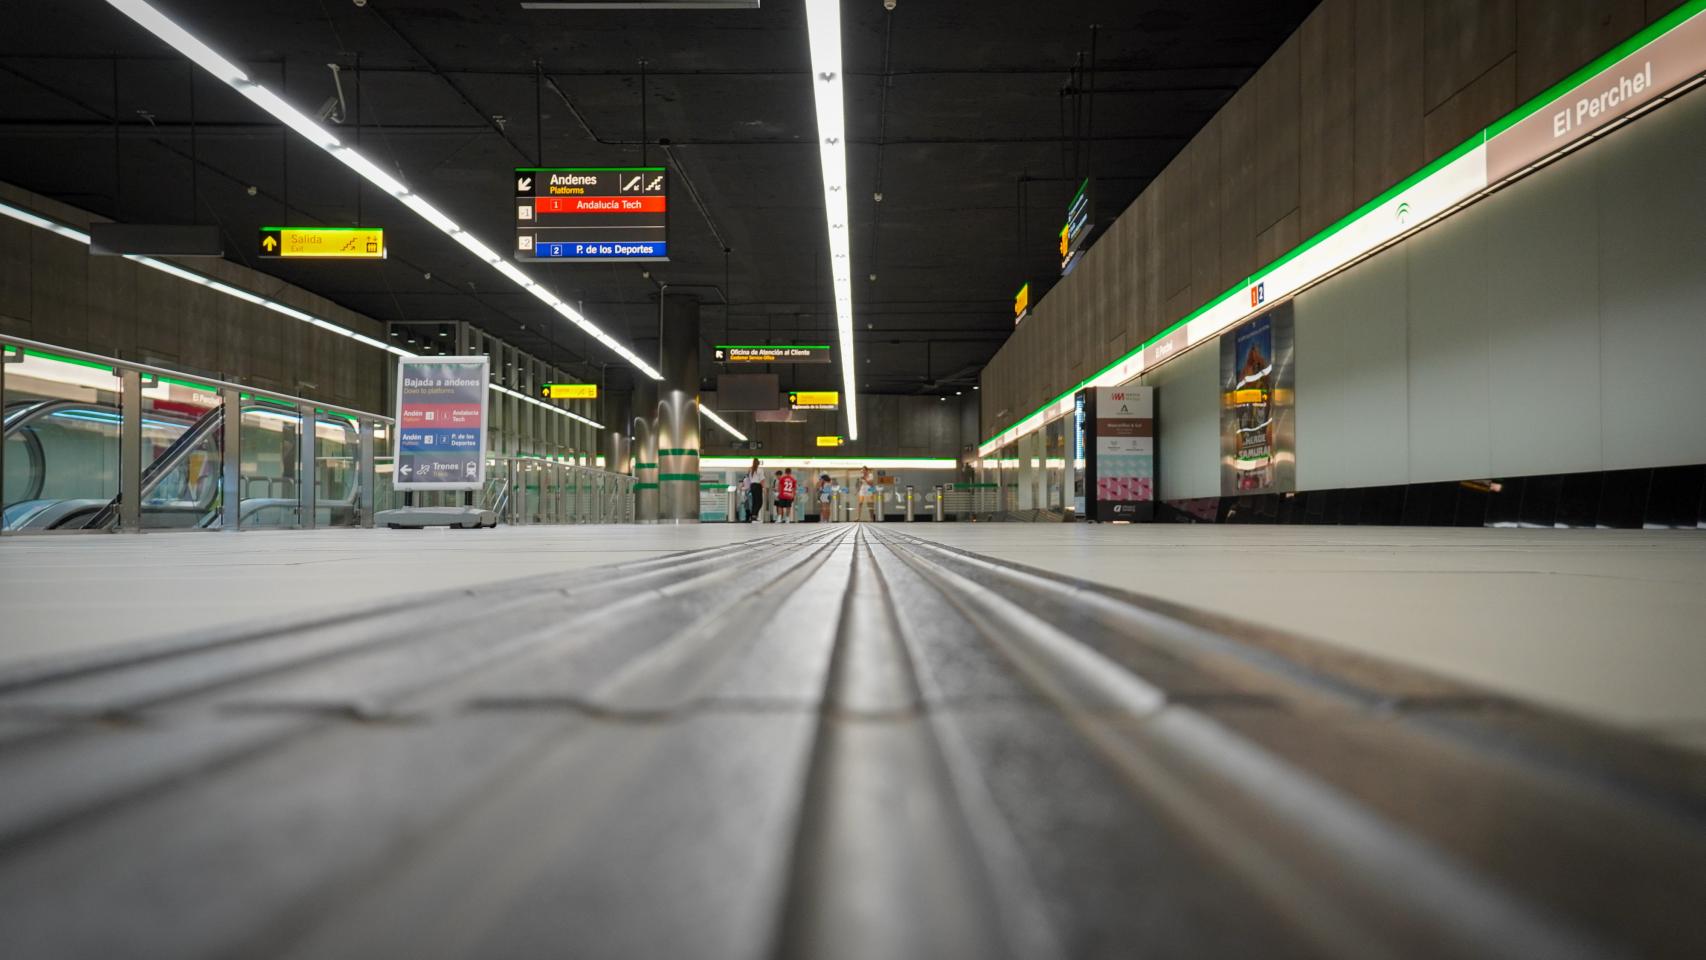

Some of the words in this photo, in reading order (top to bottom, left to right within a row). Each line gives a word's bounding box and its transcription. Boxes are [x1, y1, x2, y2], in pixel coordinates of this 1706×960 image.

[1553, 108, 1571, 138] El
[1576, 61, 1651, 126] Perchel
[550, 174, 597, 186] Andenes
[550, 186, 584, 195] Platforms
[577, 200, 619, 209] Andalucía
[622, 200, 642, 209] Tech
[291, 234, 322, 244] Salida
[576, 245, 583, 254] P.
[586, 245, 596, 254] de
[599, 245, 612, 254] los
[615, 245, 653, 256] Deportes
[404, 378, 434, 388] Bajada
[444, 378, 480, 386] andenes
[403, 409, 423, 417] Andén
[402, 433, 422, 441] Andén
[433, 462, 459, 470] Trenes
[783, 481, 793, 492] 22
